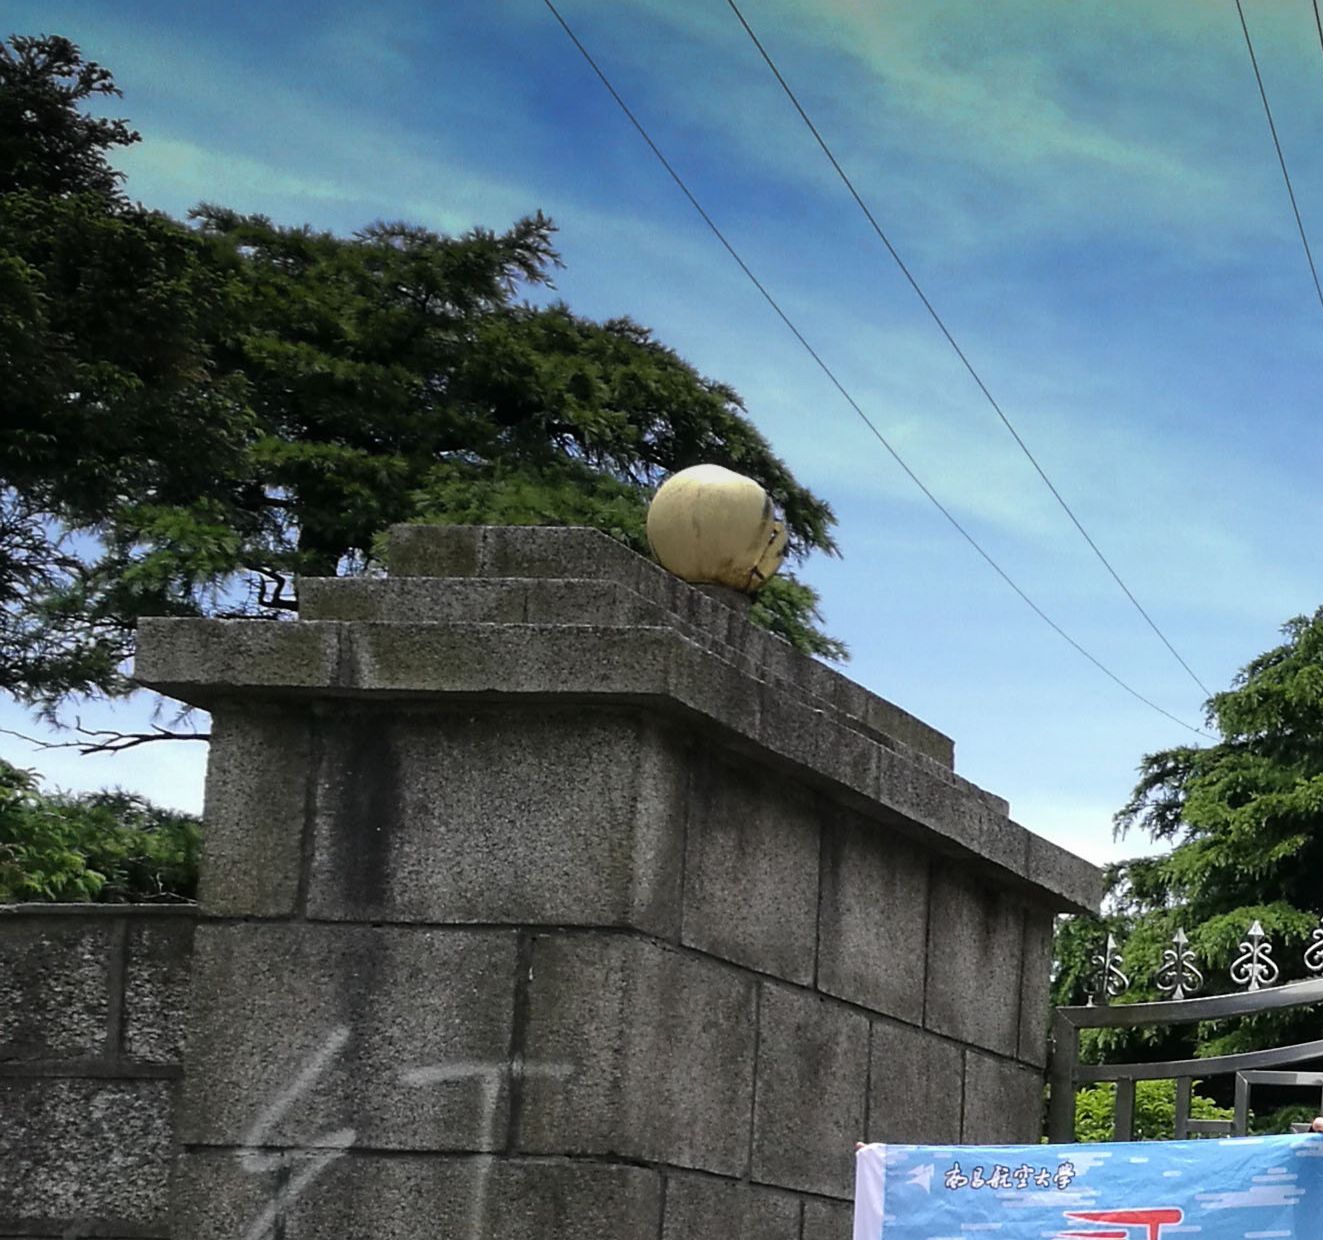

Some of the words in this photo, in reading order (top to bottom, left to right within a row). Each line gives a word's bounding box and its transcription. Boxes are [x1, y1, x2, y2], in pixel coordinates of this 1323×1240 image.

[943, 1160, 1077, 1190] 南昌航空大学
